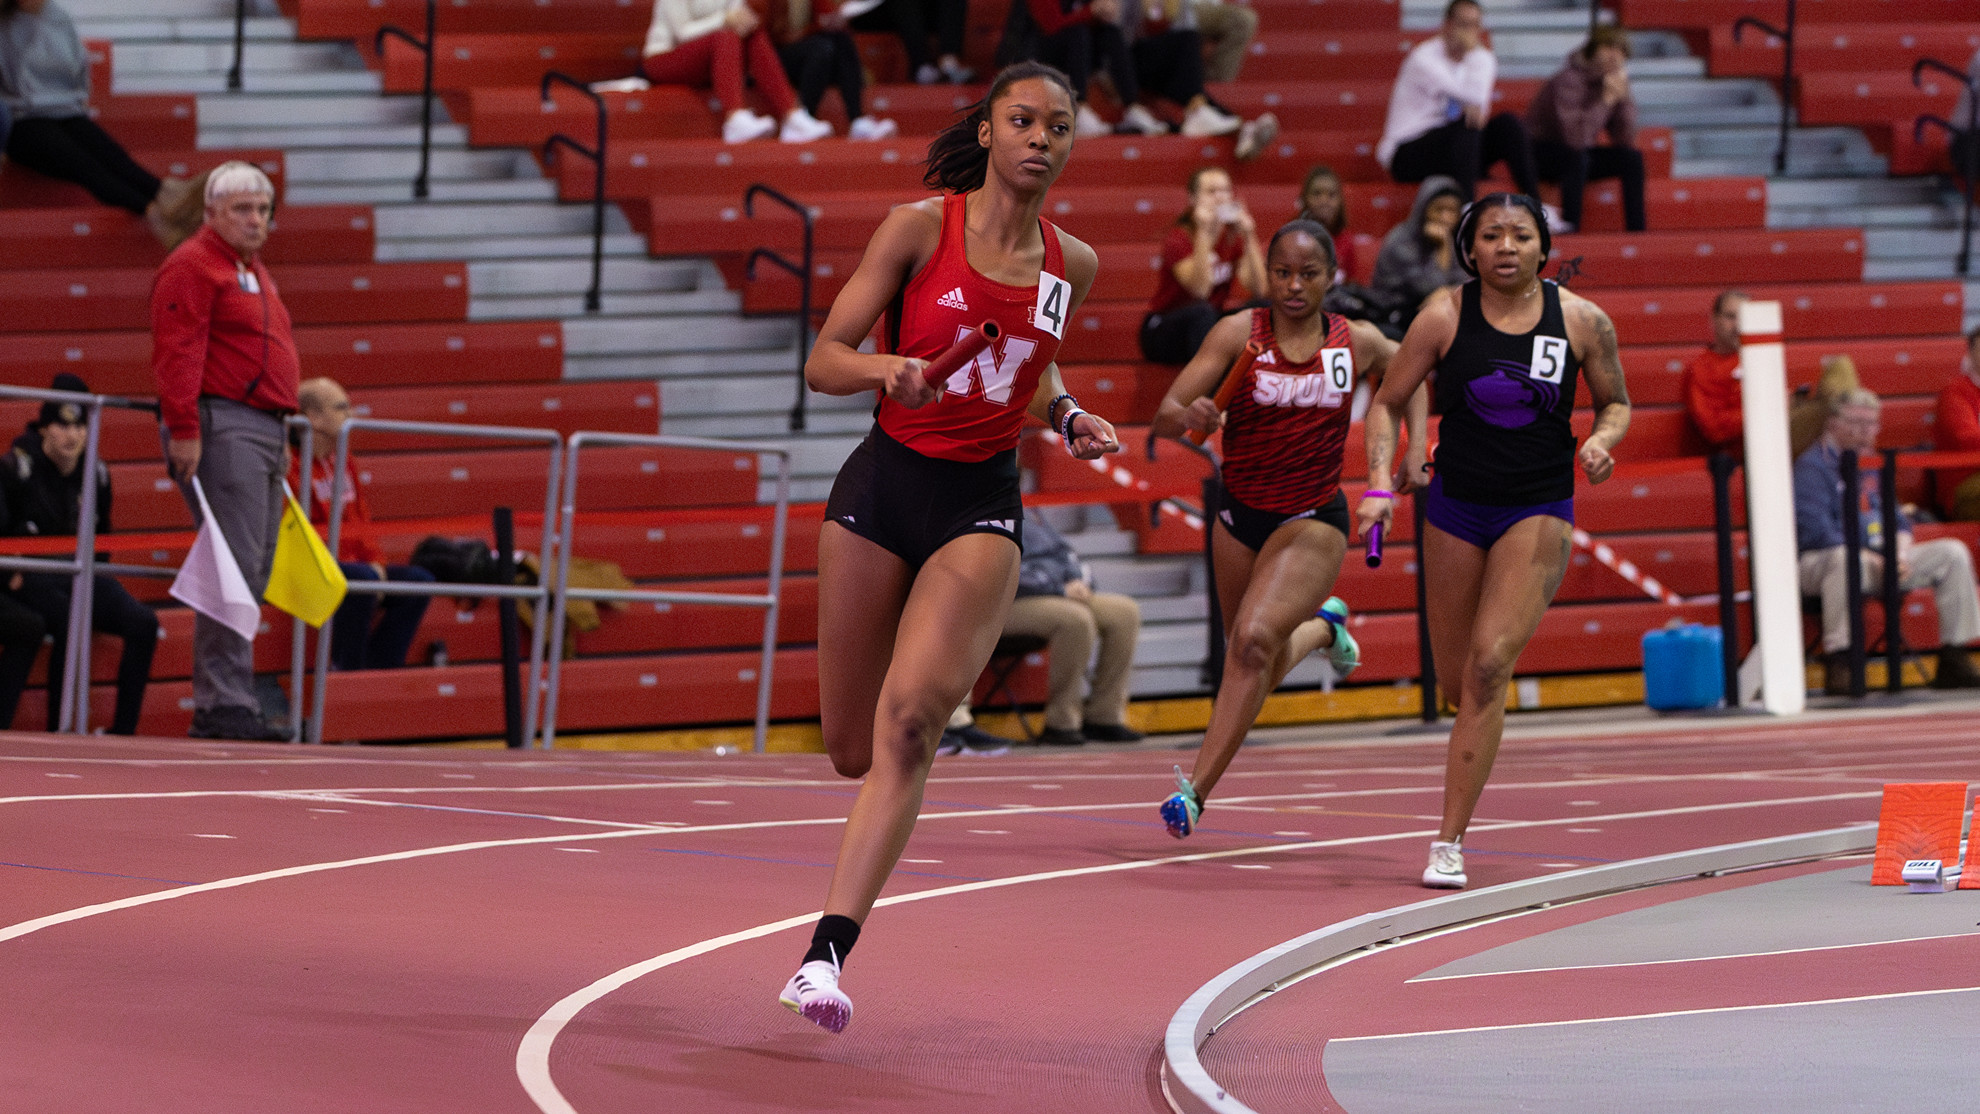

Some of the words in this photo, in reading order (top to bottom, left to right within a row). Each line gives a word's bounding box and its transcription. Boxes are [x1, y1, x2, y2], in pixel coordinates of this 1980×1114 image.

[937, 298, 968, 311] adidas
[1042, 281, 1063, 333] 4
[945, 324, 1039, 406] N
[1332, 352, 1348, 389] 6
[1539, 340, 1559, 378] 5
